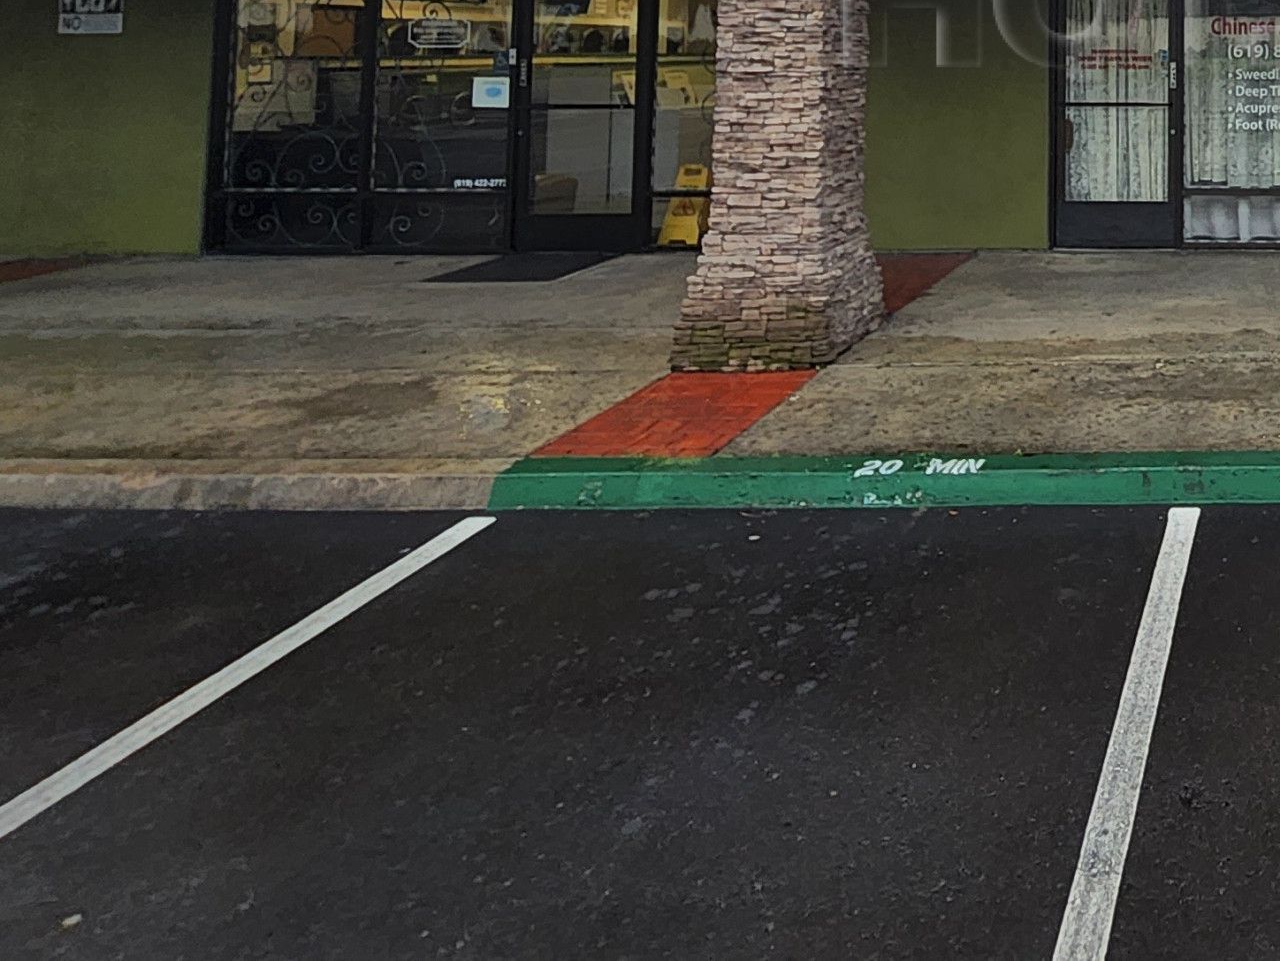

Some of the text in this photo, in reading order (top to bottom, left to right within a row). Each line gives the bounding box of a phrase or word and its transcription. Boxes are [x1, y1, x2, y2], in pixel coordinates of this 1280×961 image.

[1211, 17, 1276, 36] Chinese
[1228, 43, 1270, 60] (619)
[1235, 85, 1268, 99] Deep
[1235, 118, 1263, 131] Foot
[853, 457, 986, 478] 20 MIN
